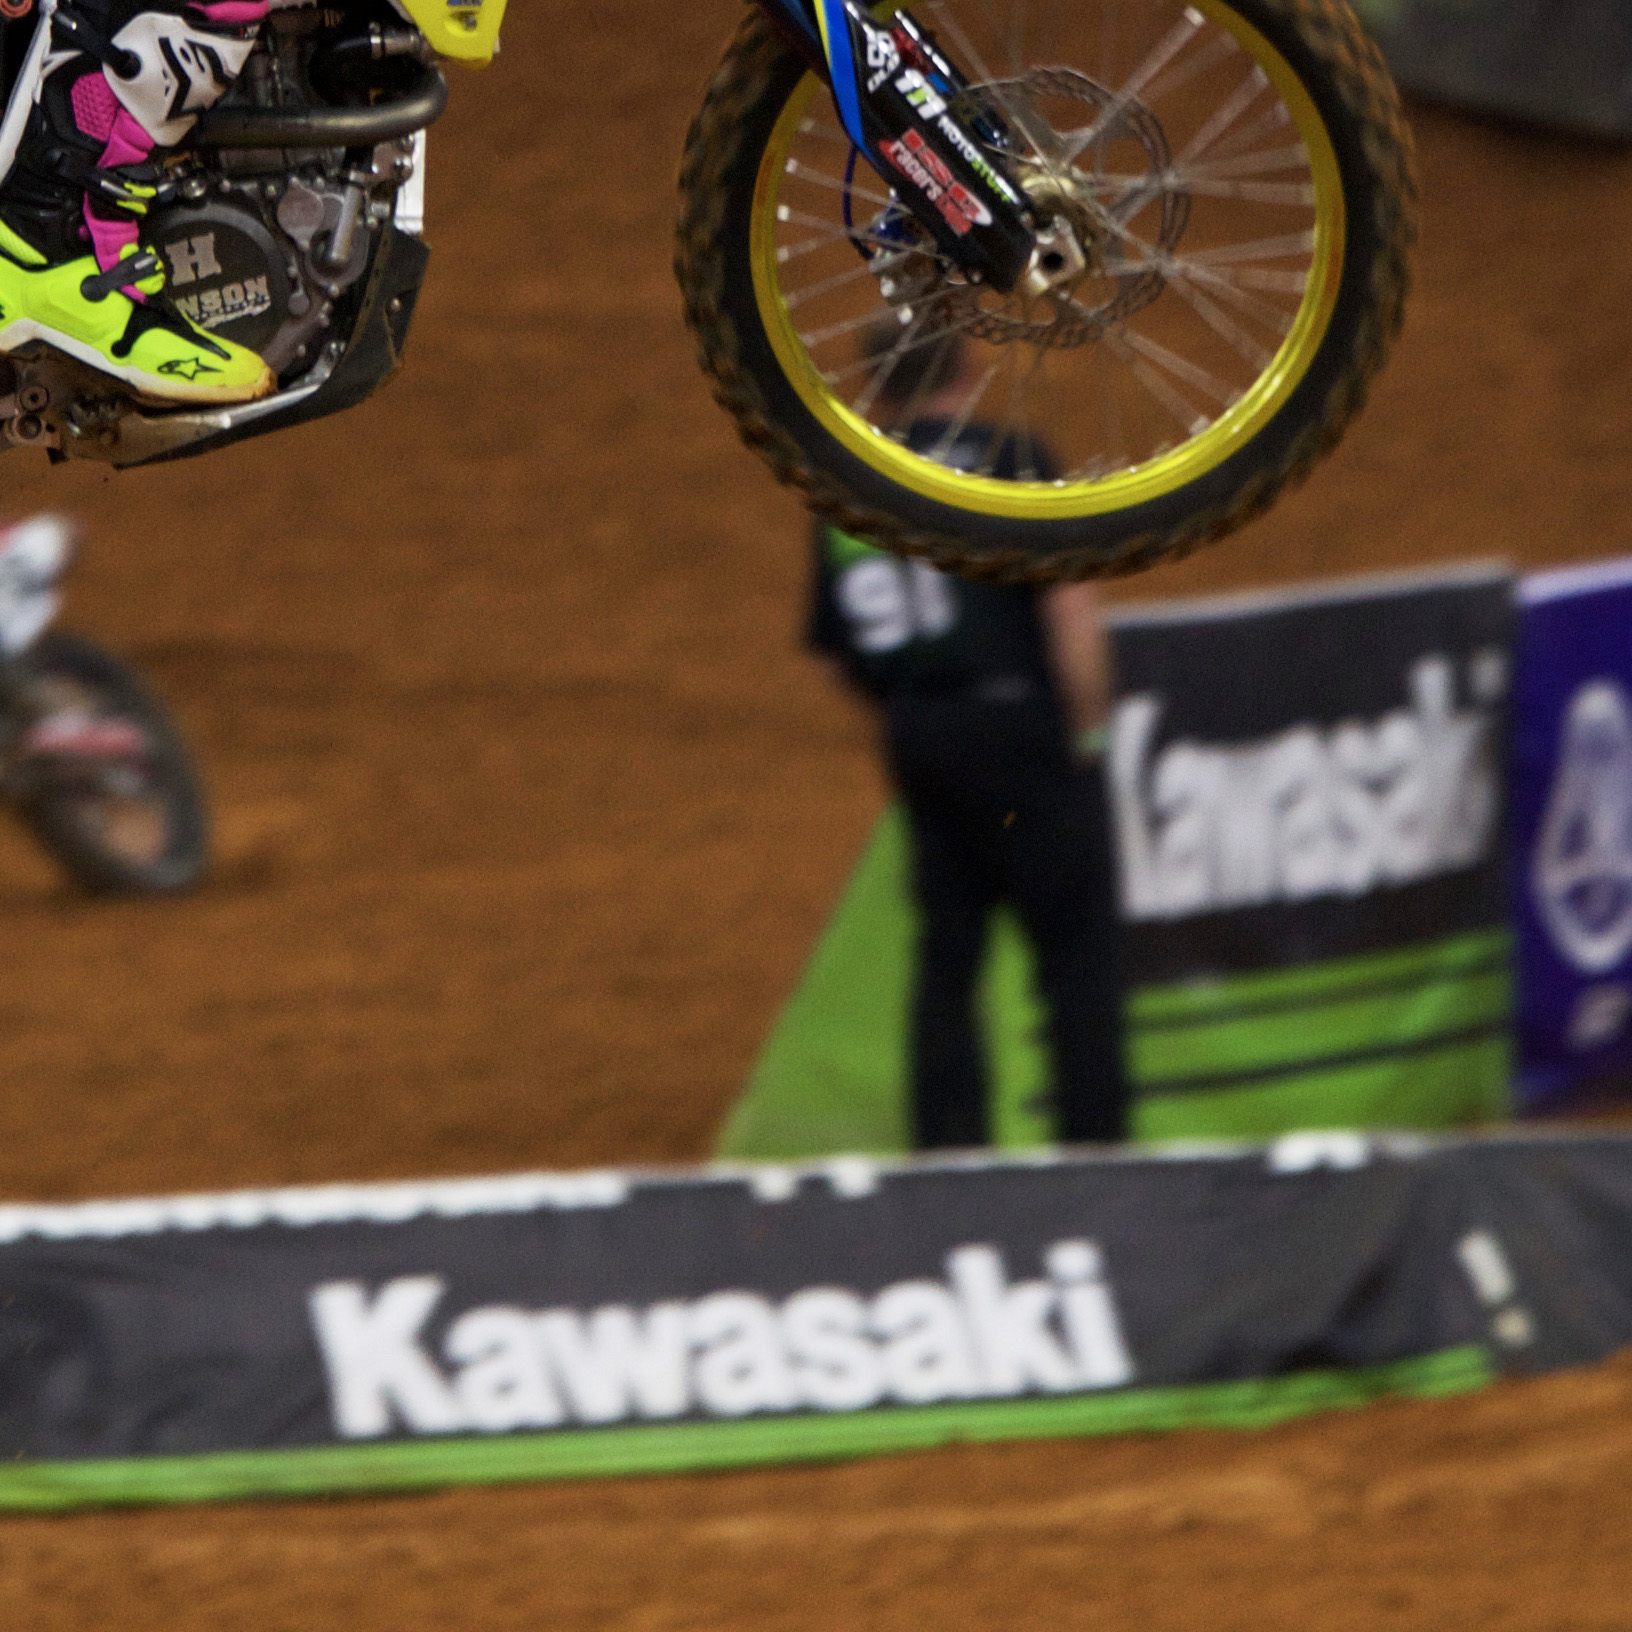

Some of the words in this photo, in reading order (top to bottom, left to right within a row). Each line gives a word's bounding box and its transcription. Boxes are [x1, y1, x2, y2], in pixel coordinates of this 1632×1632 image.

[164, 231, 223, 287] H
[174, 274, 271, 320] NSON
[311, 1238, 1136, 1439] Kawasaki
